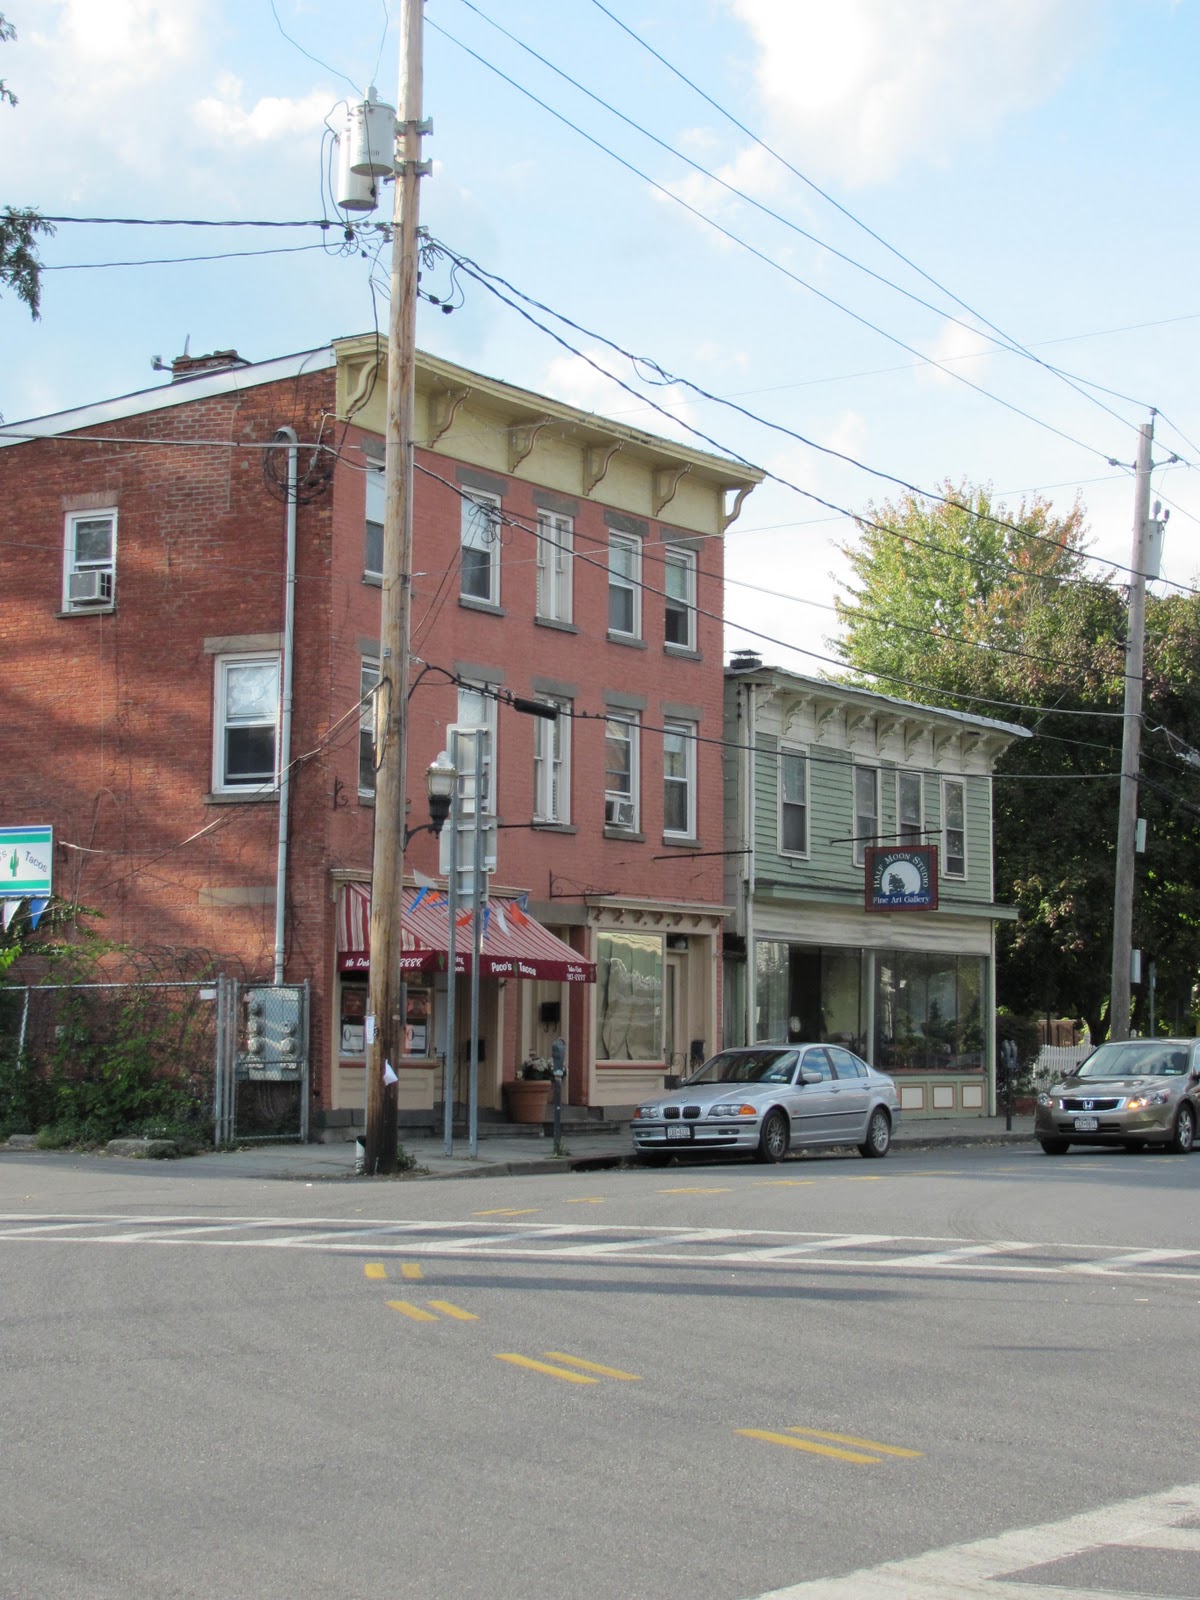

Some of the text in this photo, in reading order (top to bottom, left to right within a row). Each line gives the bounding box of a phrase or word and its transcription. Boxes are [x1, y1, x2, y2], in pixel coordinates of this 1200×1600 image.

[25, 850, 48, 873] Tacos
[873, 852, 929, 888] HALF MOON STUDIO
[873, 895, 930, 904] Fine Art Gallery
[491, 961, 537, 976] Paco's Tacos
